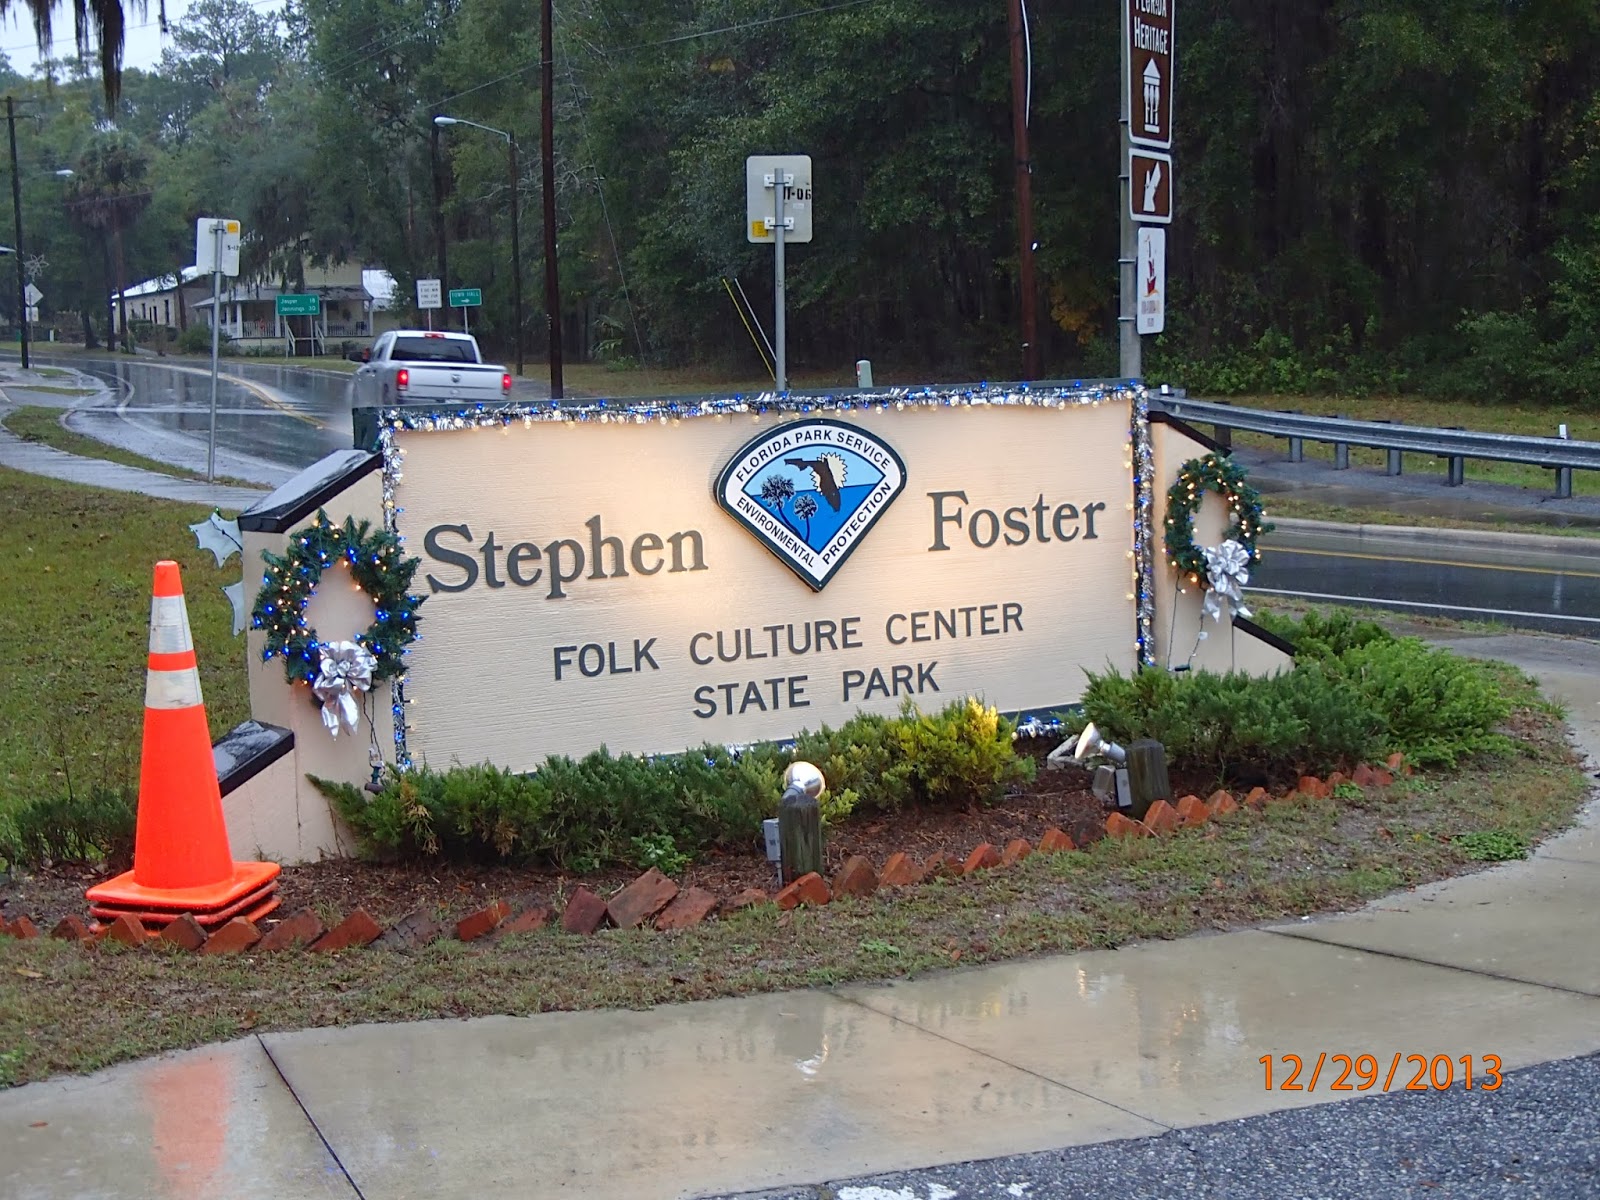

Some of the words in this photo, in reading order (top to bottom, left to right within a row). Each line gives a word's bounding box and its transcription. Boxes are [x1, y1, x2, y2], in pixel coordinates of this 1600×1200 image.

[1134, 16, 1168, 55] HERITAGE
[736, 436, 792, 482] FLORIDA
[795, 429, 833, 444] PARK
[836, 431, 891, 470] SERVICE
[423, 514, 709, 600] Stephen
[926, 490, 1106, 552] Foster
[736, 496, 815, 568] ENVIRONMENTAL
[821, 481, 892, 566] PROTECTION
[553, 637, 660, 681] FOLK
[689, 616, 863, 665] CULTURE
[885, 602, 1024, 645] CENTER
[692, 674, 811, 719] STATE
[842, 660, 940, 702] PARK
